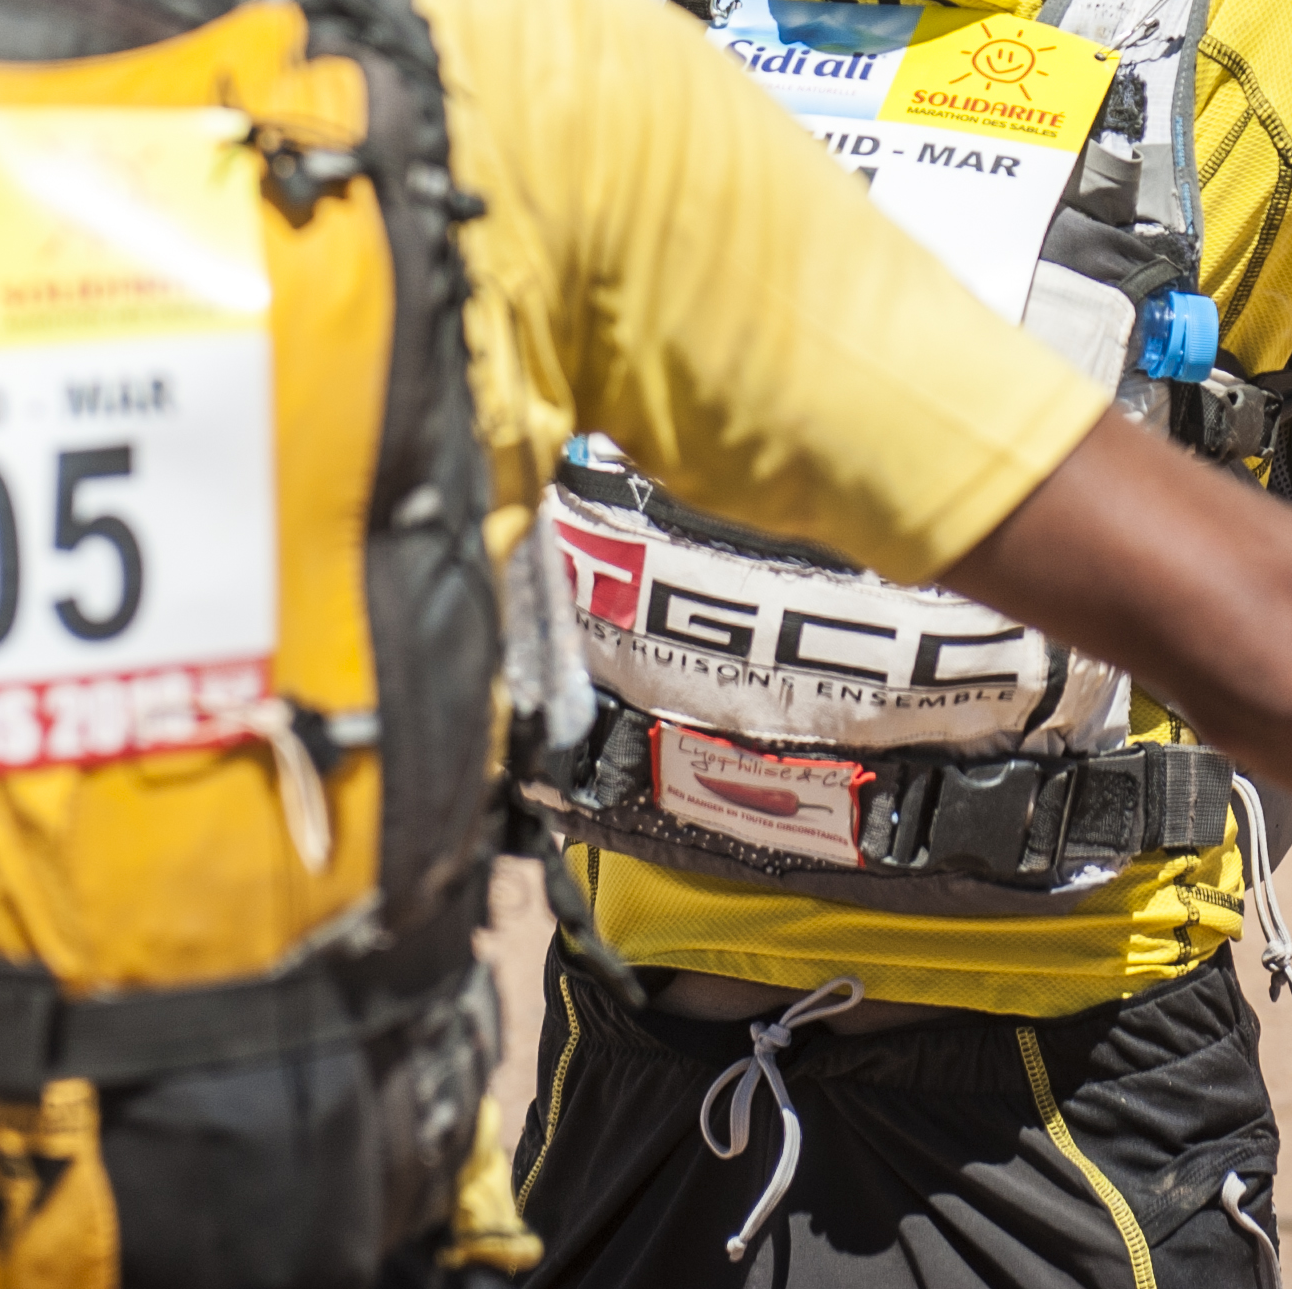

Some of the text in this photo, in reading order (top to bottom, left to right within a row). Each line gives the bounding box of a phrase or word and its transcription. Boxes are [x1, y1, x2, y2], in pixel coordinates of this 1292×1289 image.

[724, 39, 878, 81] Sidi ali
[906, 106, 1058, 139] MARATHON DES SABLES
[911, 89, 1067, 129] SOLIDARITÉ
[916, 142, 1022, 178] MAR
[553, 529, 1025, 688] TGCC
[816, 678, 1015, 710] ENSEMBLE
